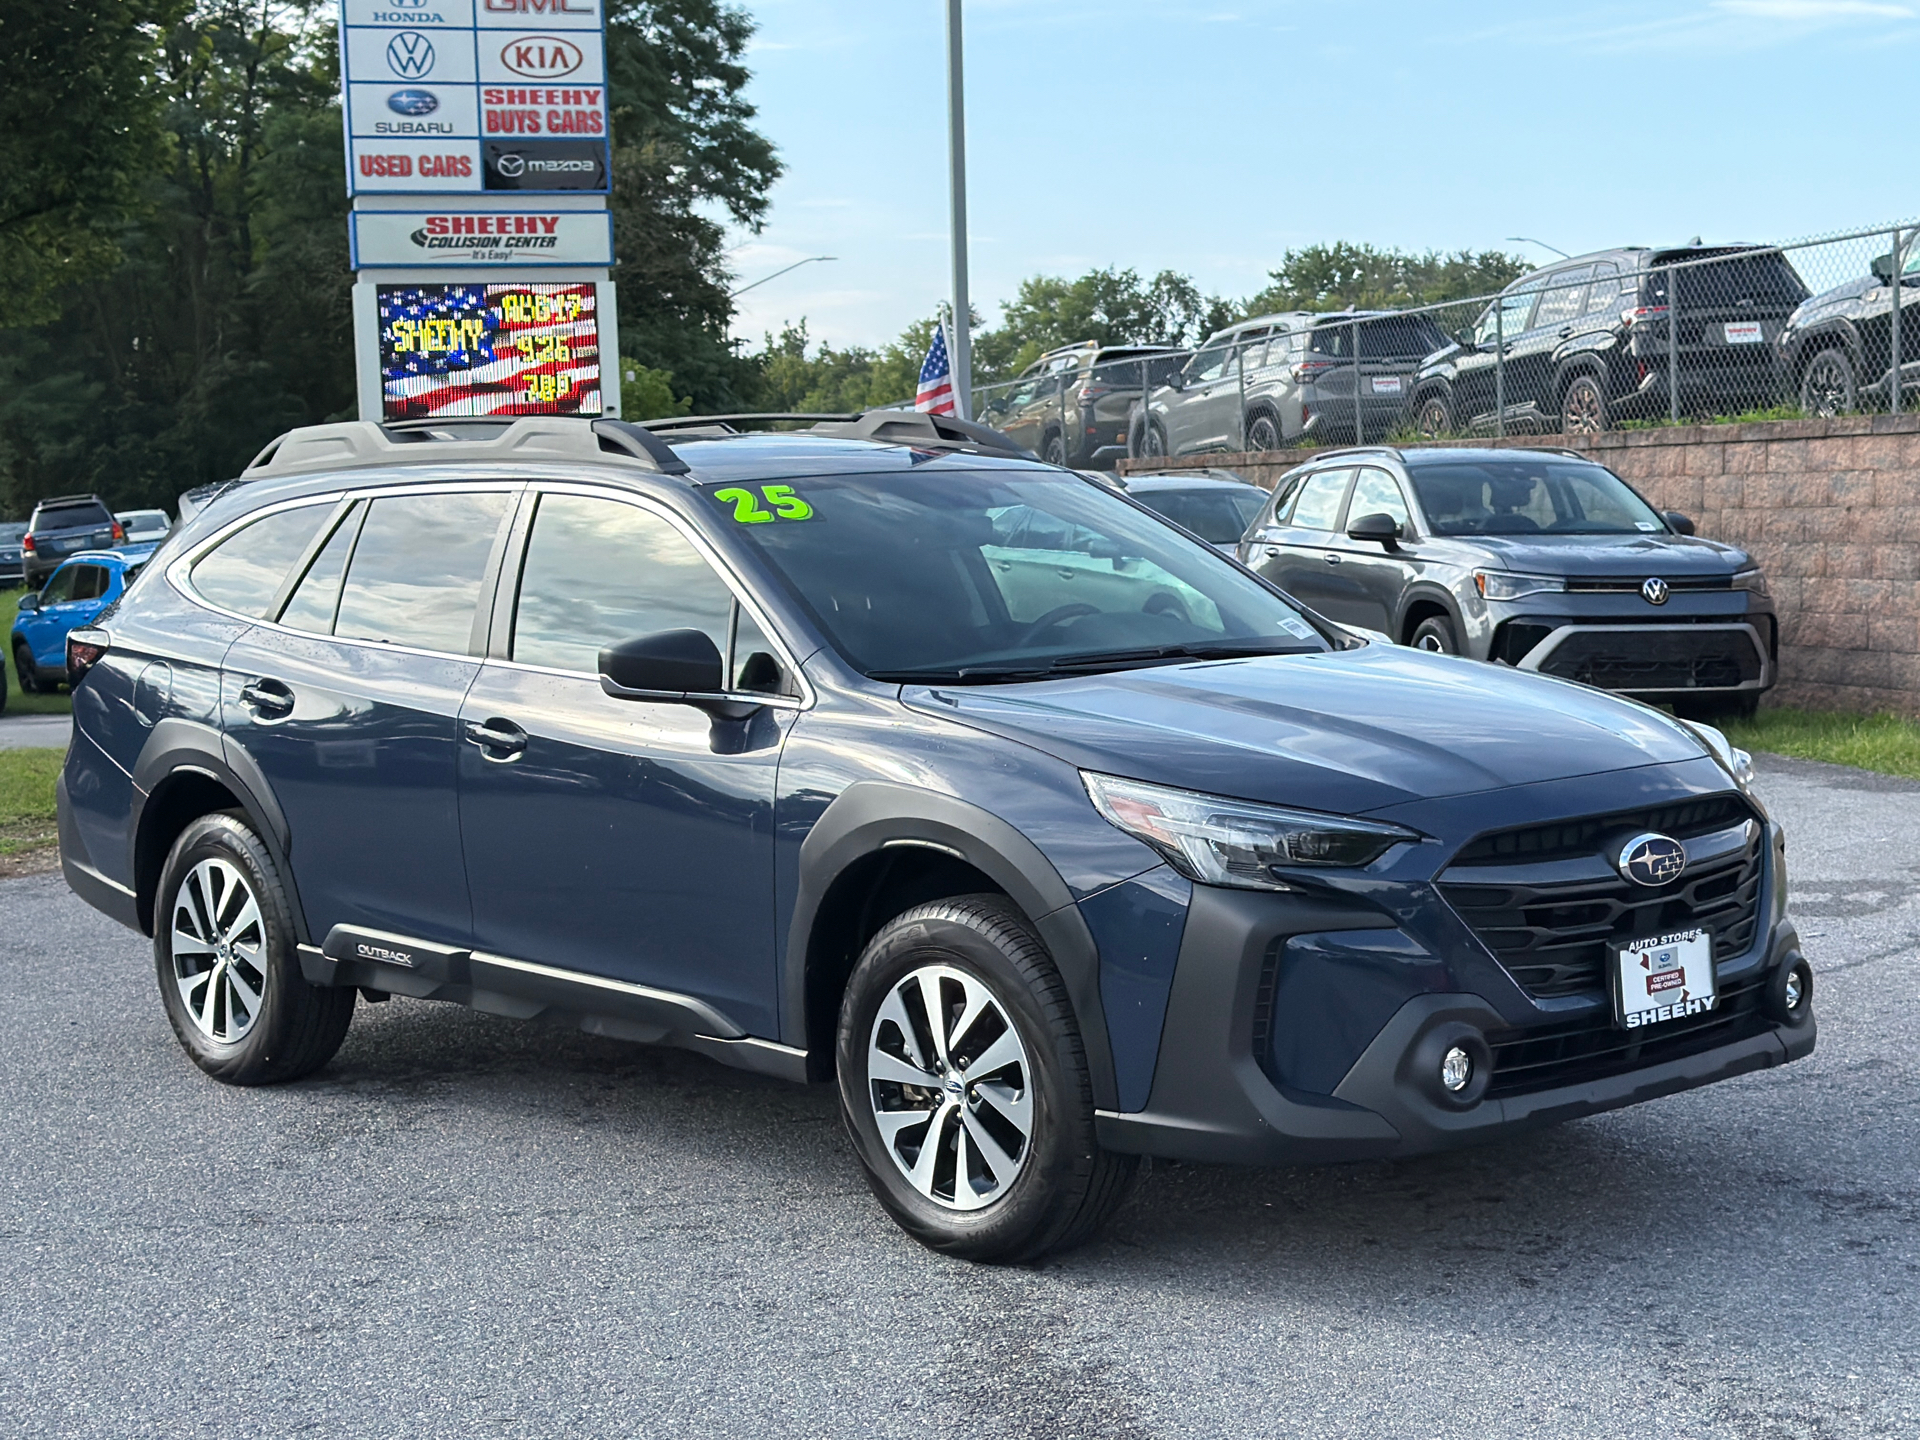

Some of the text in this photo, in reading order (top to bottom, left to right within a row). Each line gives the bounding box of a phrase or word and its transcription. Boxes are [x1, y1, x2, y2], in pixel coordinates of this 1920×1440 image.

[373, 12, 445, 23] HONDA
[514, 46, 570, 69] KIA
[484, 89, 601, 105] SHEEHY
[375, 122, 453, 133] SUBARU
[486, 110, 603, 134] BUYS CARS
[360, 155, 472, 177] USED CARS
[425, 216, 560, 235] SHEEHY
[427, 236, 558, 249] COLLISION CENTER
[472, 250, 513, 261] It's Easy!
[392, 319, 484, 352] SHEEHY
[714, 485, 814, 523] 25
[1629, 929, 1702, 951] AUTO STORES
[357, 944, 412, 964] OUTBACK
[1651, 978, 1682, 991] PRE-OWNED
[1653, 972, 1679, 983] CERTIFIED
[1626, 996, 1716, 1028] SHEEHY
